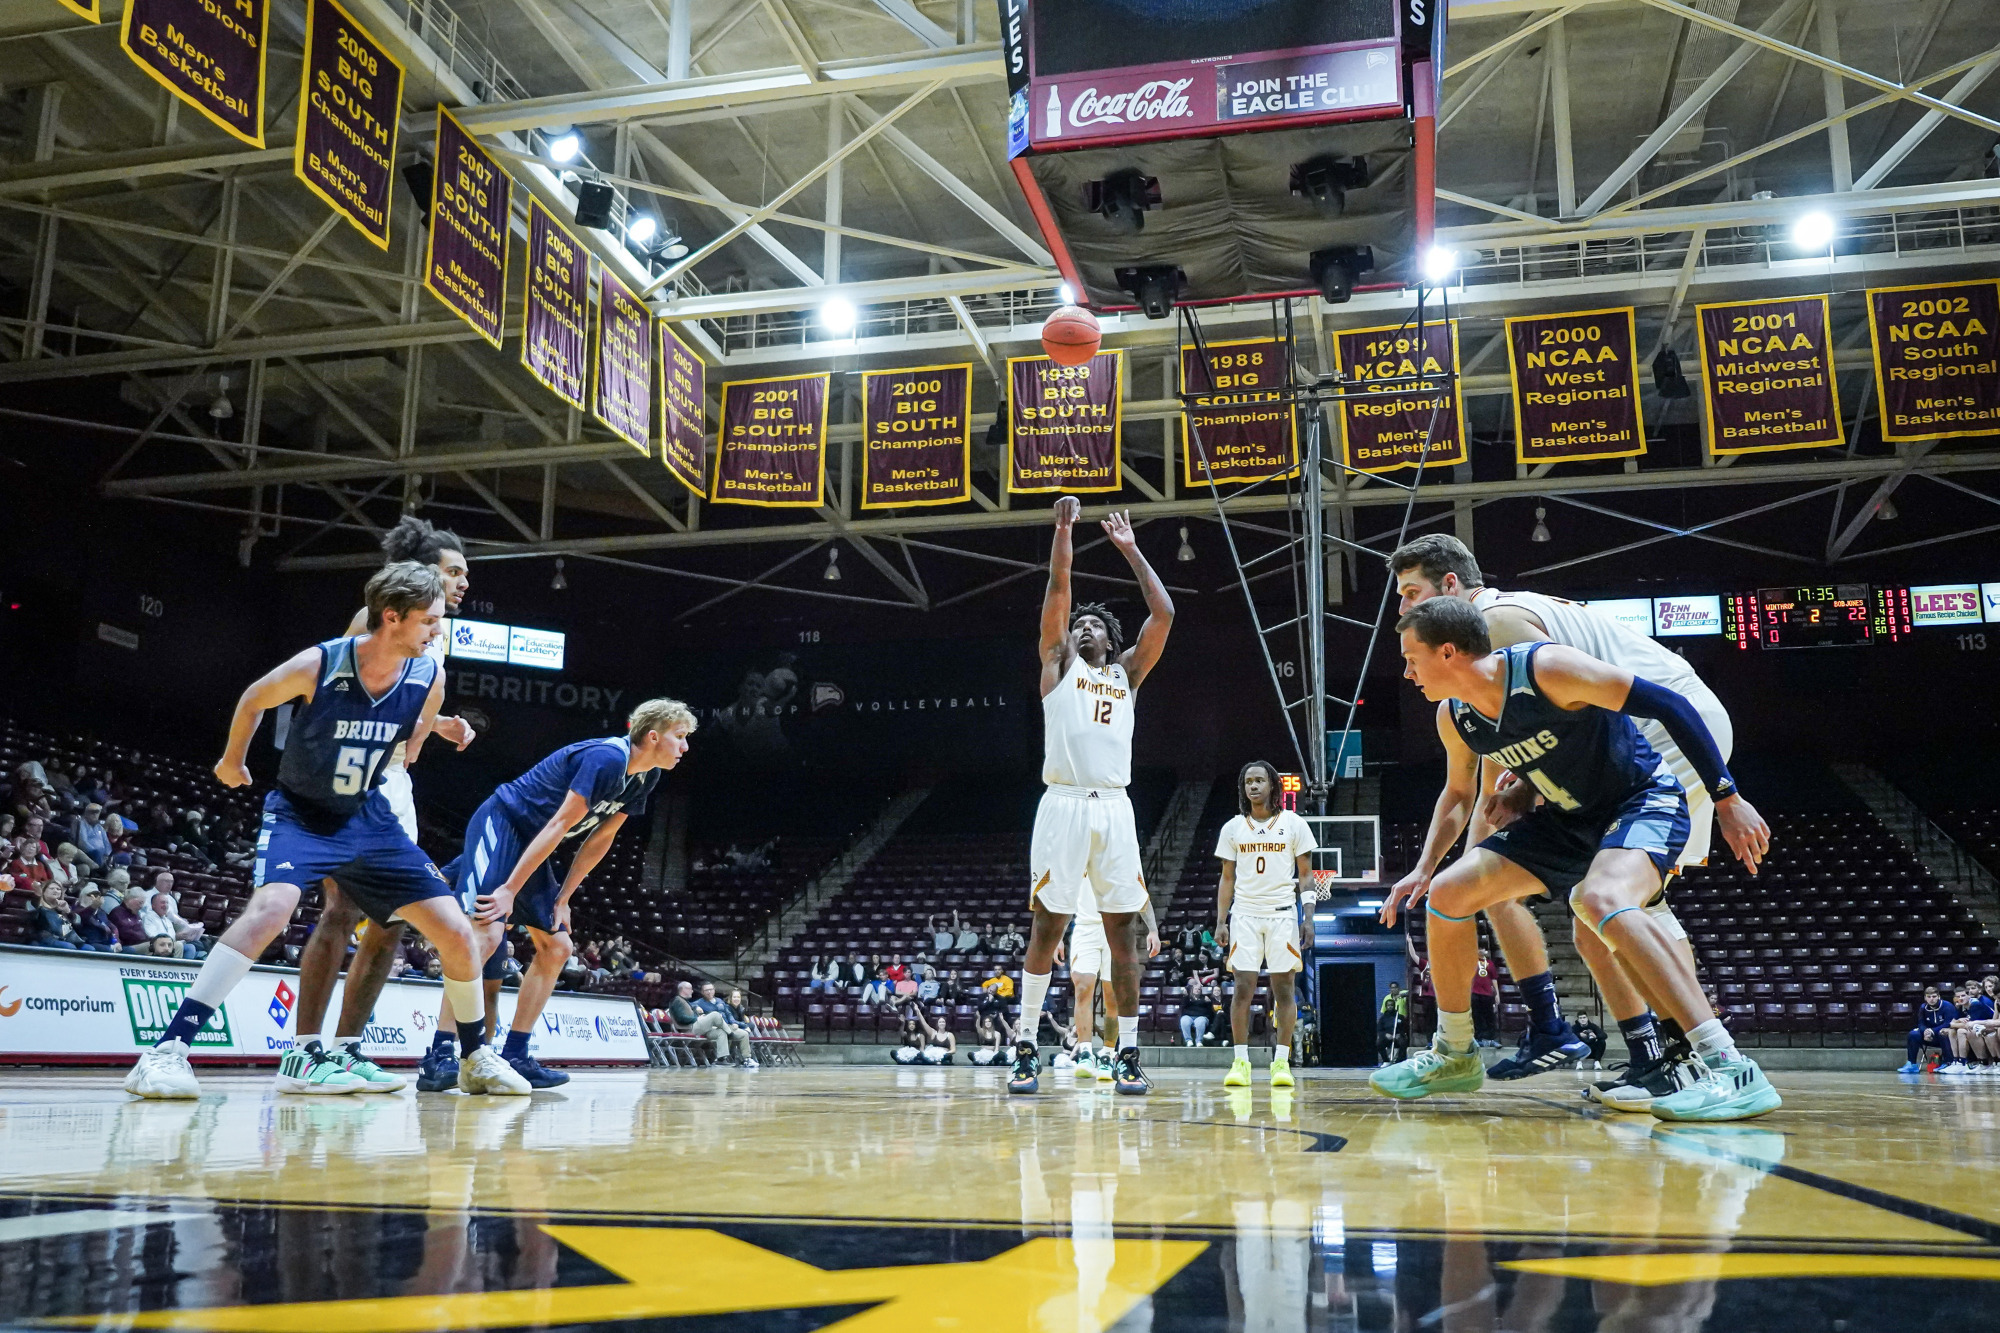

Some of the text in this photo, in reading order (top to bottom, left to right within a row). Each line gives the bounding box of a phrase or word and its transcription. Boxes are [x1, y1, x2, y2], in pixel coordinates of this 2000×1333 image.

[166, 23, 225, 81] Men's
[337, 28, 378, 77] 2008
[140, 24, 248, 117] Basketball
[339, 57, 374, 99] BIG
[1231, 72, 1328, 97] JOIN THE
[318, 70, 389, 145] SOUTH
[1068, 77, 1194, 127] Coca-Cola
[1232, 83, 1384, 116] EAGLE CLU
[311, 92, 390, 170] Champions
[328, 149, 367, 194] Men's
[459, 145, 493, 186] 2007
[309, 153, 383, 226] Basketball
[459, 171, 488, 208] BIG
[444, 183, 501, 247] SOUTH
[436, 202, 502, 270] Champions
[547, 230, 573, 264] 2006
[547, 252, 570, 284] BIG
[450, 260, 485, 298] Men's
[435, 264, 498, 326] Basketball
[535, 266, 582, 317] SOUTH
[531, 286, 584, 339] Champions
[613, 292, 641, 328] 2005
[1902, 296, 1970, 318] 2002
[615, 317, 637, 344] BIG
[1732, 312, 1796, 333] 2001
[1889, 318, 1987, 343] NCAA
[1540, 326, 1601, 346] 2000
[1718, 332, 1814, 357] NCAA
[606, 329, 648, 374] SOUTH
[1366, 336, 1428, 358] 1999
[1904, 342, 1979, 361] South
[673, 348, 693, 376] 2002
[1210, 352, 1264, 370] 1988
[1527, 345, 1618, 369] NCAA
[1716, 356, 1821, 377] Midwest
[1038, 366, 1091, 382] 1999
[1354, 356, 1443, 380] NCAA
[1889, 360, 1997, 381] Regional
[675, 369, 692, 393] BIG
[892, 380, 941, 396] 2000
[1216, 372, 1259, 389] BIG
[1545, 370, 1606, 387] West
[1718, 373, 1823, 395] Regional
[668, 380, 701, 420] SOUTH
[753, 389, 798, 403] 2001
[1043, 385, 1085, 400] BIG
[1196, 391, 1281, 407] SOUTH
[1526, 384, 1628, 407] Regional
[613, 389, 640, 416] Men's
[896, 400, 937, 414] BIG
[1022, 404, 1107, 420] SOUTH
[1353, 396, 1451, 418] Regional
[1916, 396, 1976, 410] Men's
[666, 397, 703, 437] Champions
[754, 407, 794, 419] BIG
[1192, 410, 1289, 428] Champions
[1744, 408, 1803, 423] Men's
[1895, 407, 2000, 426] Basketball
[732, 423, 813, 437] SOUTH
[876, 416, 957, 434] SOUTH
[1015, 423, 1112, 436] Champions
[1551, 419, 1607, 433] Men's
[1723, 419, 1828, 438] Basketball
[869, 434, 963, 450] Champions
[1377, 430, 1430, 444] Men's
[1530, 430, 1631, 449] Basketball
[676, 437, 695, 461] Men's
[726, 442, 817, 453] Champions
[1216, 443, 1266, 456] Men's
[1357, 439, 1453, 460] Basketball
[1039, 454, 1089, 466] Men's
[1197, 454, 1287, 472] Basketball
[745, 469, 793, 480] Men's
[891, 467, 940, 480] Men's
[1020, 466, 1109, 480] Basketball
[725, 480, 812, 493] Basketball
[872, 477, 959, 493] Basketball
[1797, 587, 1835, 601] 17:35
[1914, 593, 1977, 612] LEE'S
[140, 595, 163, 617] 120
[471, 600, 494, 614] 119
[1659, 602, 1691, 618] PENN
[1765, 603, 1795, 611] WINTHROP
[1810, 609, 1820, 622] 2
[1848, 607, 1867, 621] 22
[1662, 611, 1710, 629] STATION
[1767, 611, 1788, 624] 51
[799, 631, 821, 643] 118
[1770, 629, 1780, 643] 0
[1864, 626, 1870, 638] 1
[1957, 633, 1987, 650] 113
[526, 639, 564, 650] Education
[526, 646, 559, 657] Lottery
[1275, 661, 1295, 678] 16
[697, 705, 797, 717] INTHROP
[856, 696, 1006, 712] VOLLEYBALL
[1093, 700, 1112, 725] 12
[334, 720, 402, 742] BRUIN
[1484, 730, 1559, 768] RUINS
[1526, 768, 1582, 811] 4
[1239, 842, 1286, 853] WINTHROP
[1256, 856, 1266, 874] 0
[120, 968, 146, 978] EVERY
[148, 970, 181, 980] SEASON
[25, 996, 115, 1016] comporium
[560, 1013, 590, 1026] Williams
[606, 1016, 637, 1028] York County
[196, 1032, 228, 1042] GOODS
[609, 1027, 639, 1037] Natural Gas
